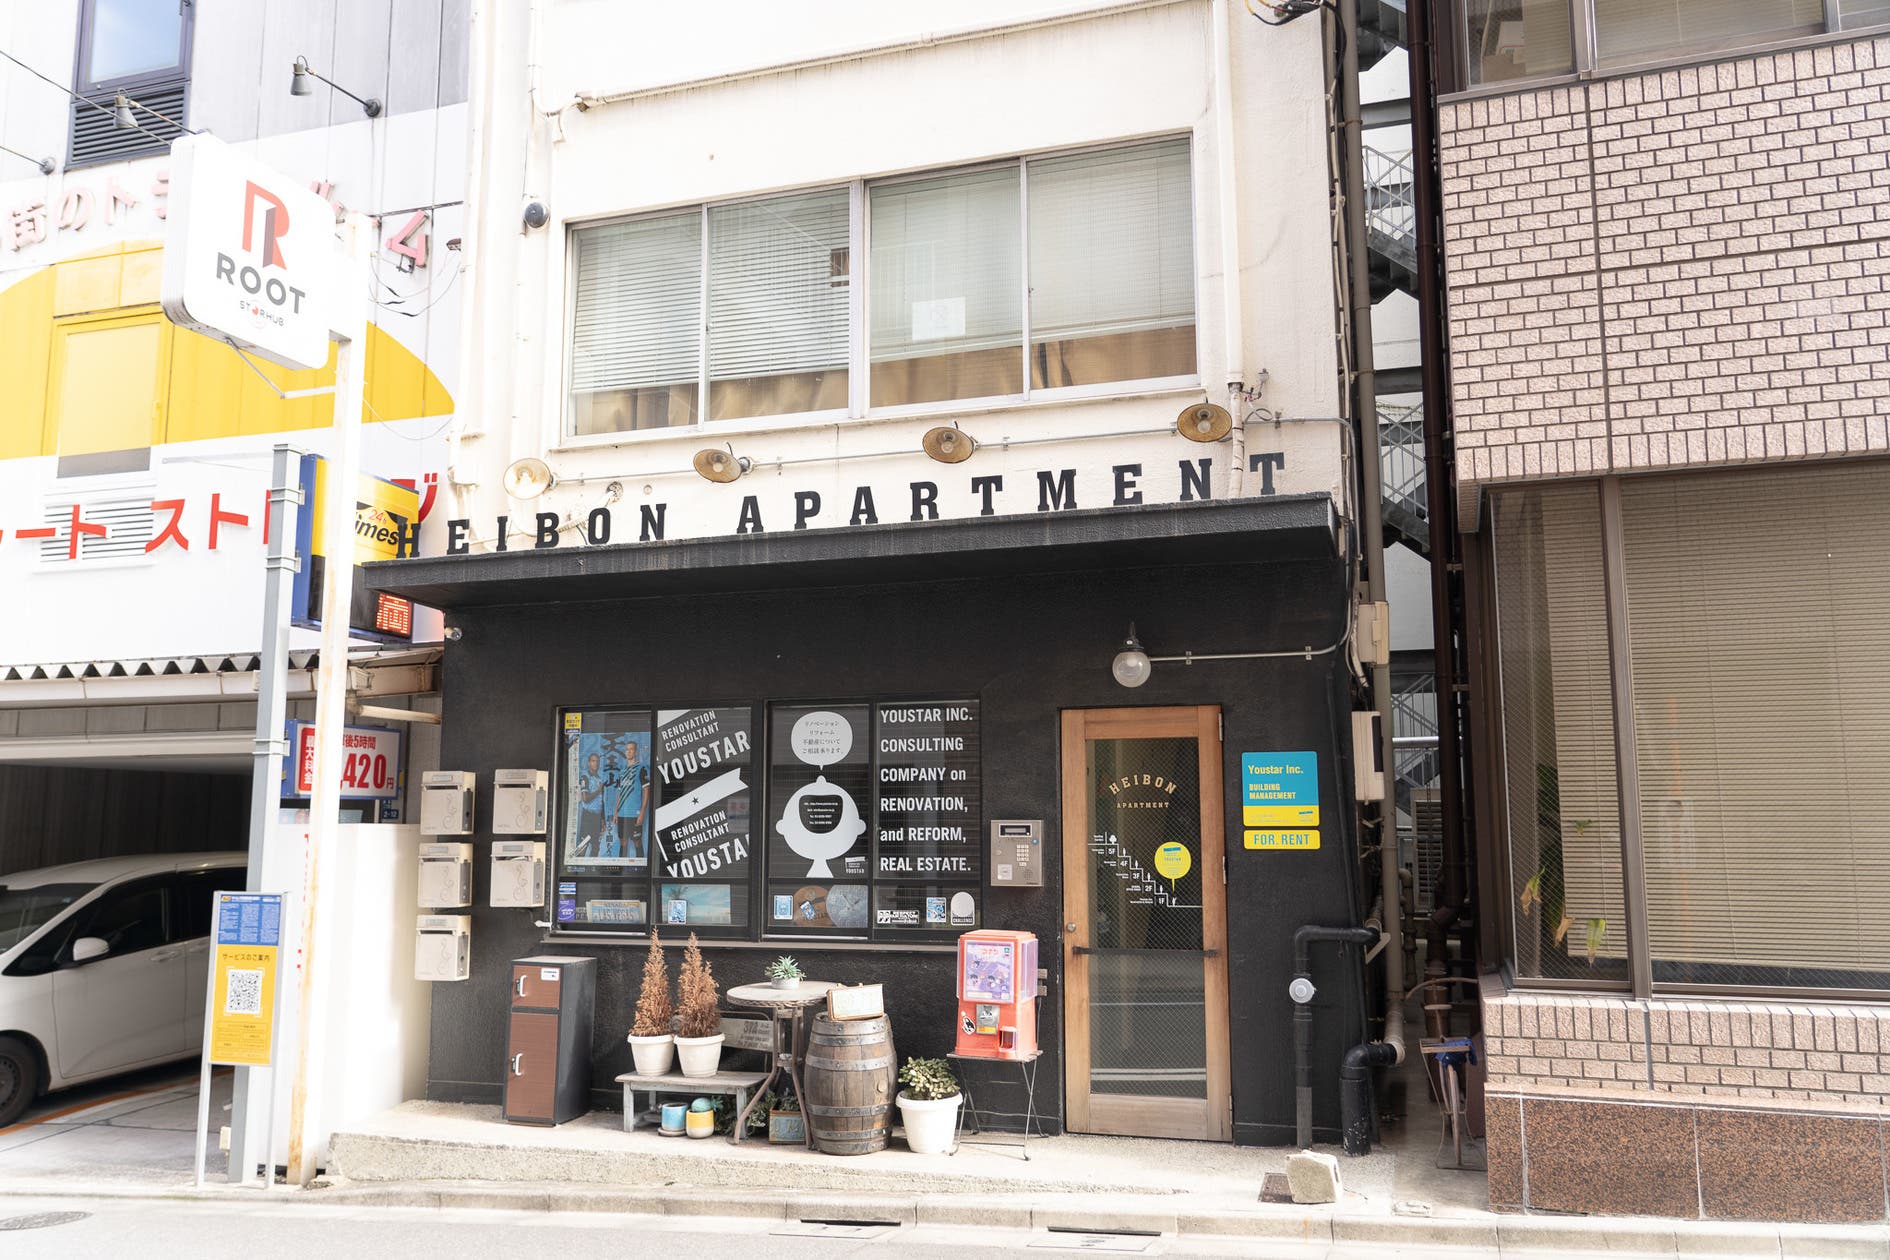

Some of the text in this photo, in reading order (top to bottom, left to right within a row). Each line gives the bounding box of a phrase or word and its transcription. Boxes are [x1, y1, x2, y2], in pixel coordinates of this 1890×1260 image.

[216, 252, 306, 314] ROOT
[396, 452, 1285, 559] HEIBON APARTMENT
[355, 514, 400, 546] imes
[880, 707, 973, 723] YOUSTAR INC.
[661, 710, 717, 741] RENOVATION
[343, 734, 376, 750] 後5時間
[665, 721, 720, 752] CONSULTANT
[880, 737, 963, 753] CONSULTING
[658, 730, 751, 785] YOUSTAR
[880, 767, 966, 782] COMPANY on
[1247, 764, 1304, 775] Youstar Inc.
[1109, 773, 1177, 795] HEIBON
[880, 797, 968, 813] RENOVATION,
[671, 810, 727, 841] RENOVATION
[674, 822, 730, 853] CONSULTANT
[880, 827, 967, 844] and REFORM,
[1281, 834, 1310, 845] RENT
[666, 833, 750, 878] YOUSTA
[880, 857, 972, 872] REAL ESTATE.
[222, 953, 270, 962] サービスのご案内
